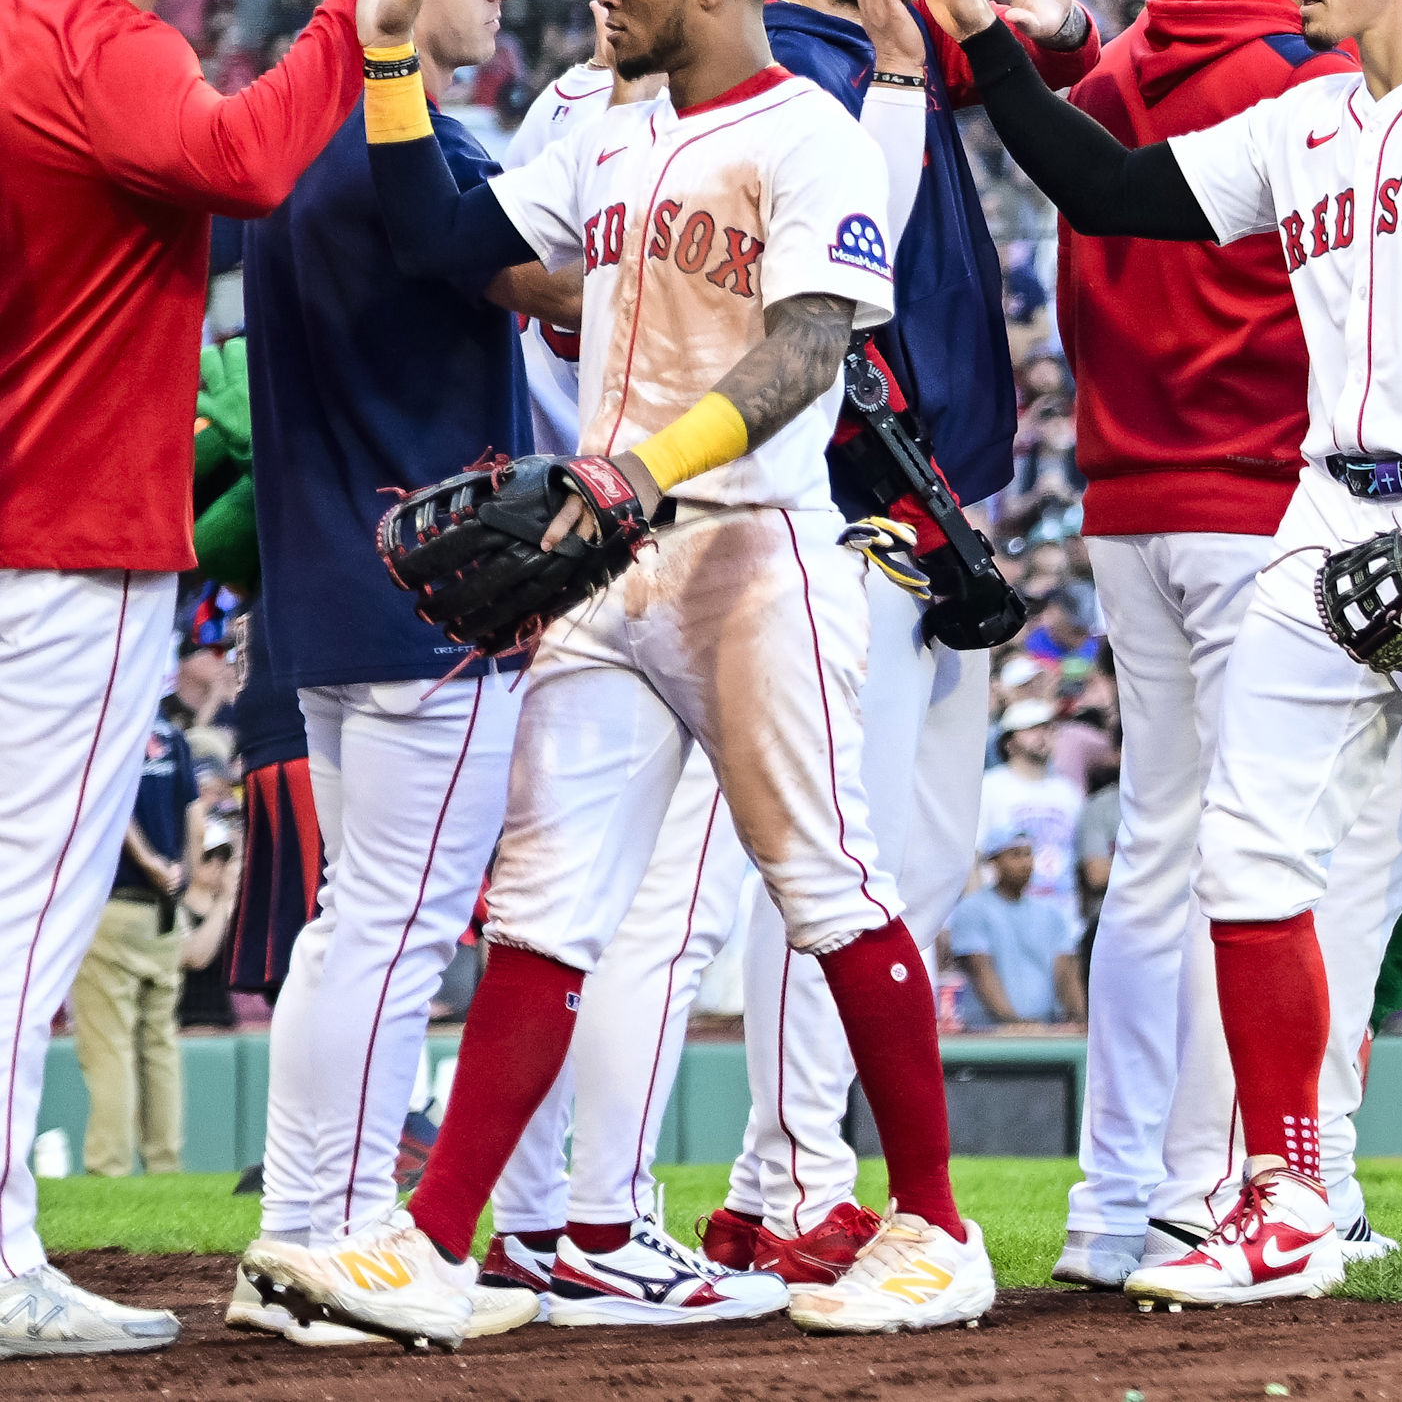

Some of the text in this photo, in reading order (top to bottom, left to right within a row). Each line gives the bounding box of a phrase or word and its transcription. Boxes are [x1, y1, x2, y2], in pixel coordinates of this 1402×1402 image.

[583, 199, 765, 298] ED SOX
[831, 248, 890, 276] MassMutual
[1280, 188, 1354, 274] RED
